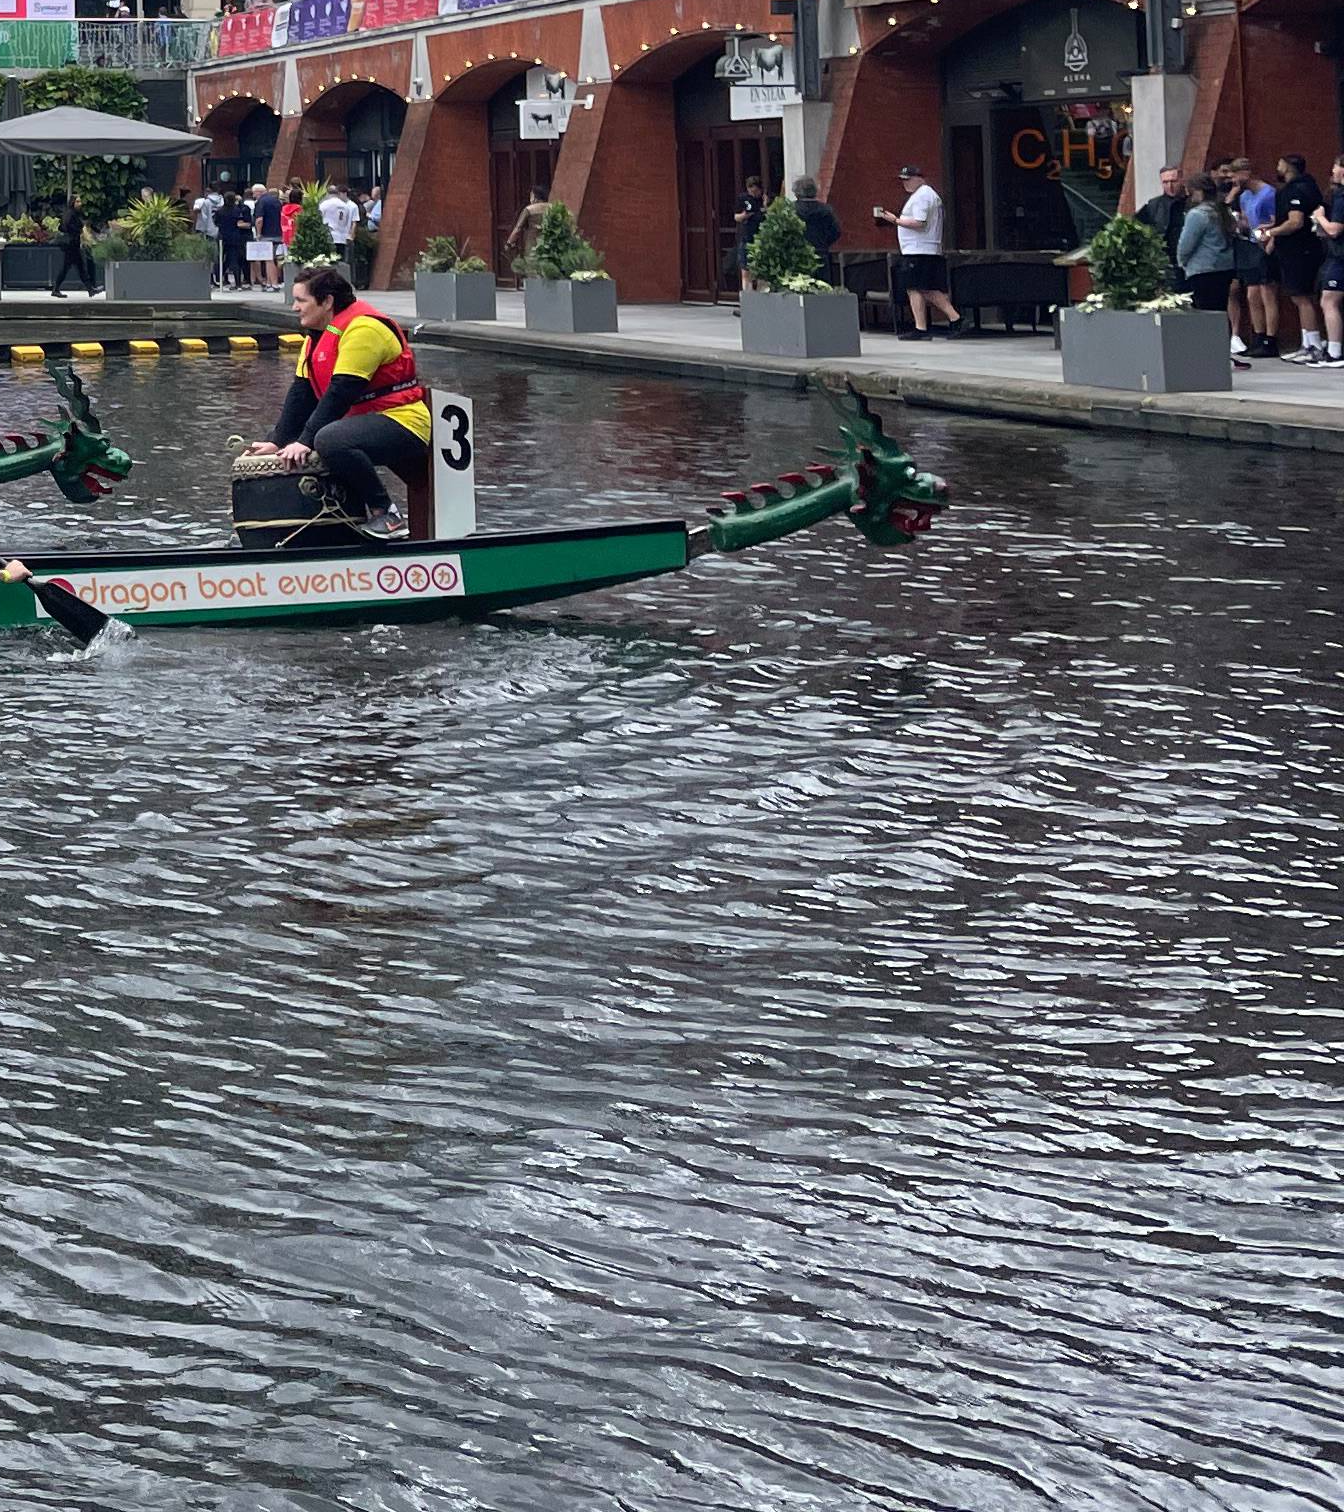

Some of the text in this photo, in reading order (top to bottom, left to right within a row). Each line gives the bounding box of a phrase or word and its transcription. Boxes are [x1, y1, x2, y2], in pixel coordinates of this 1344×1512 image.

[440, 404, 472, 471] 3
[78, 577, 187, 611] dragon
[197, 571, 266, 599] boat
[279, 568, 373, 595] events
